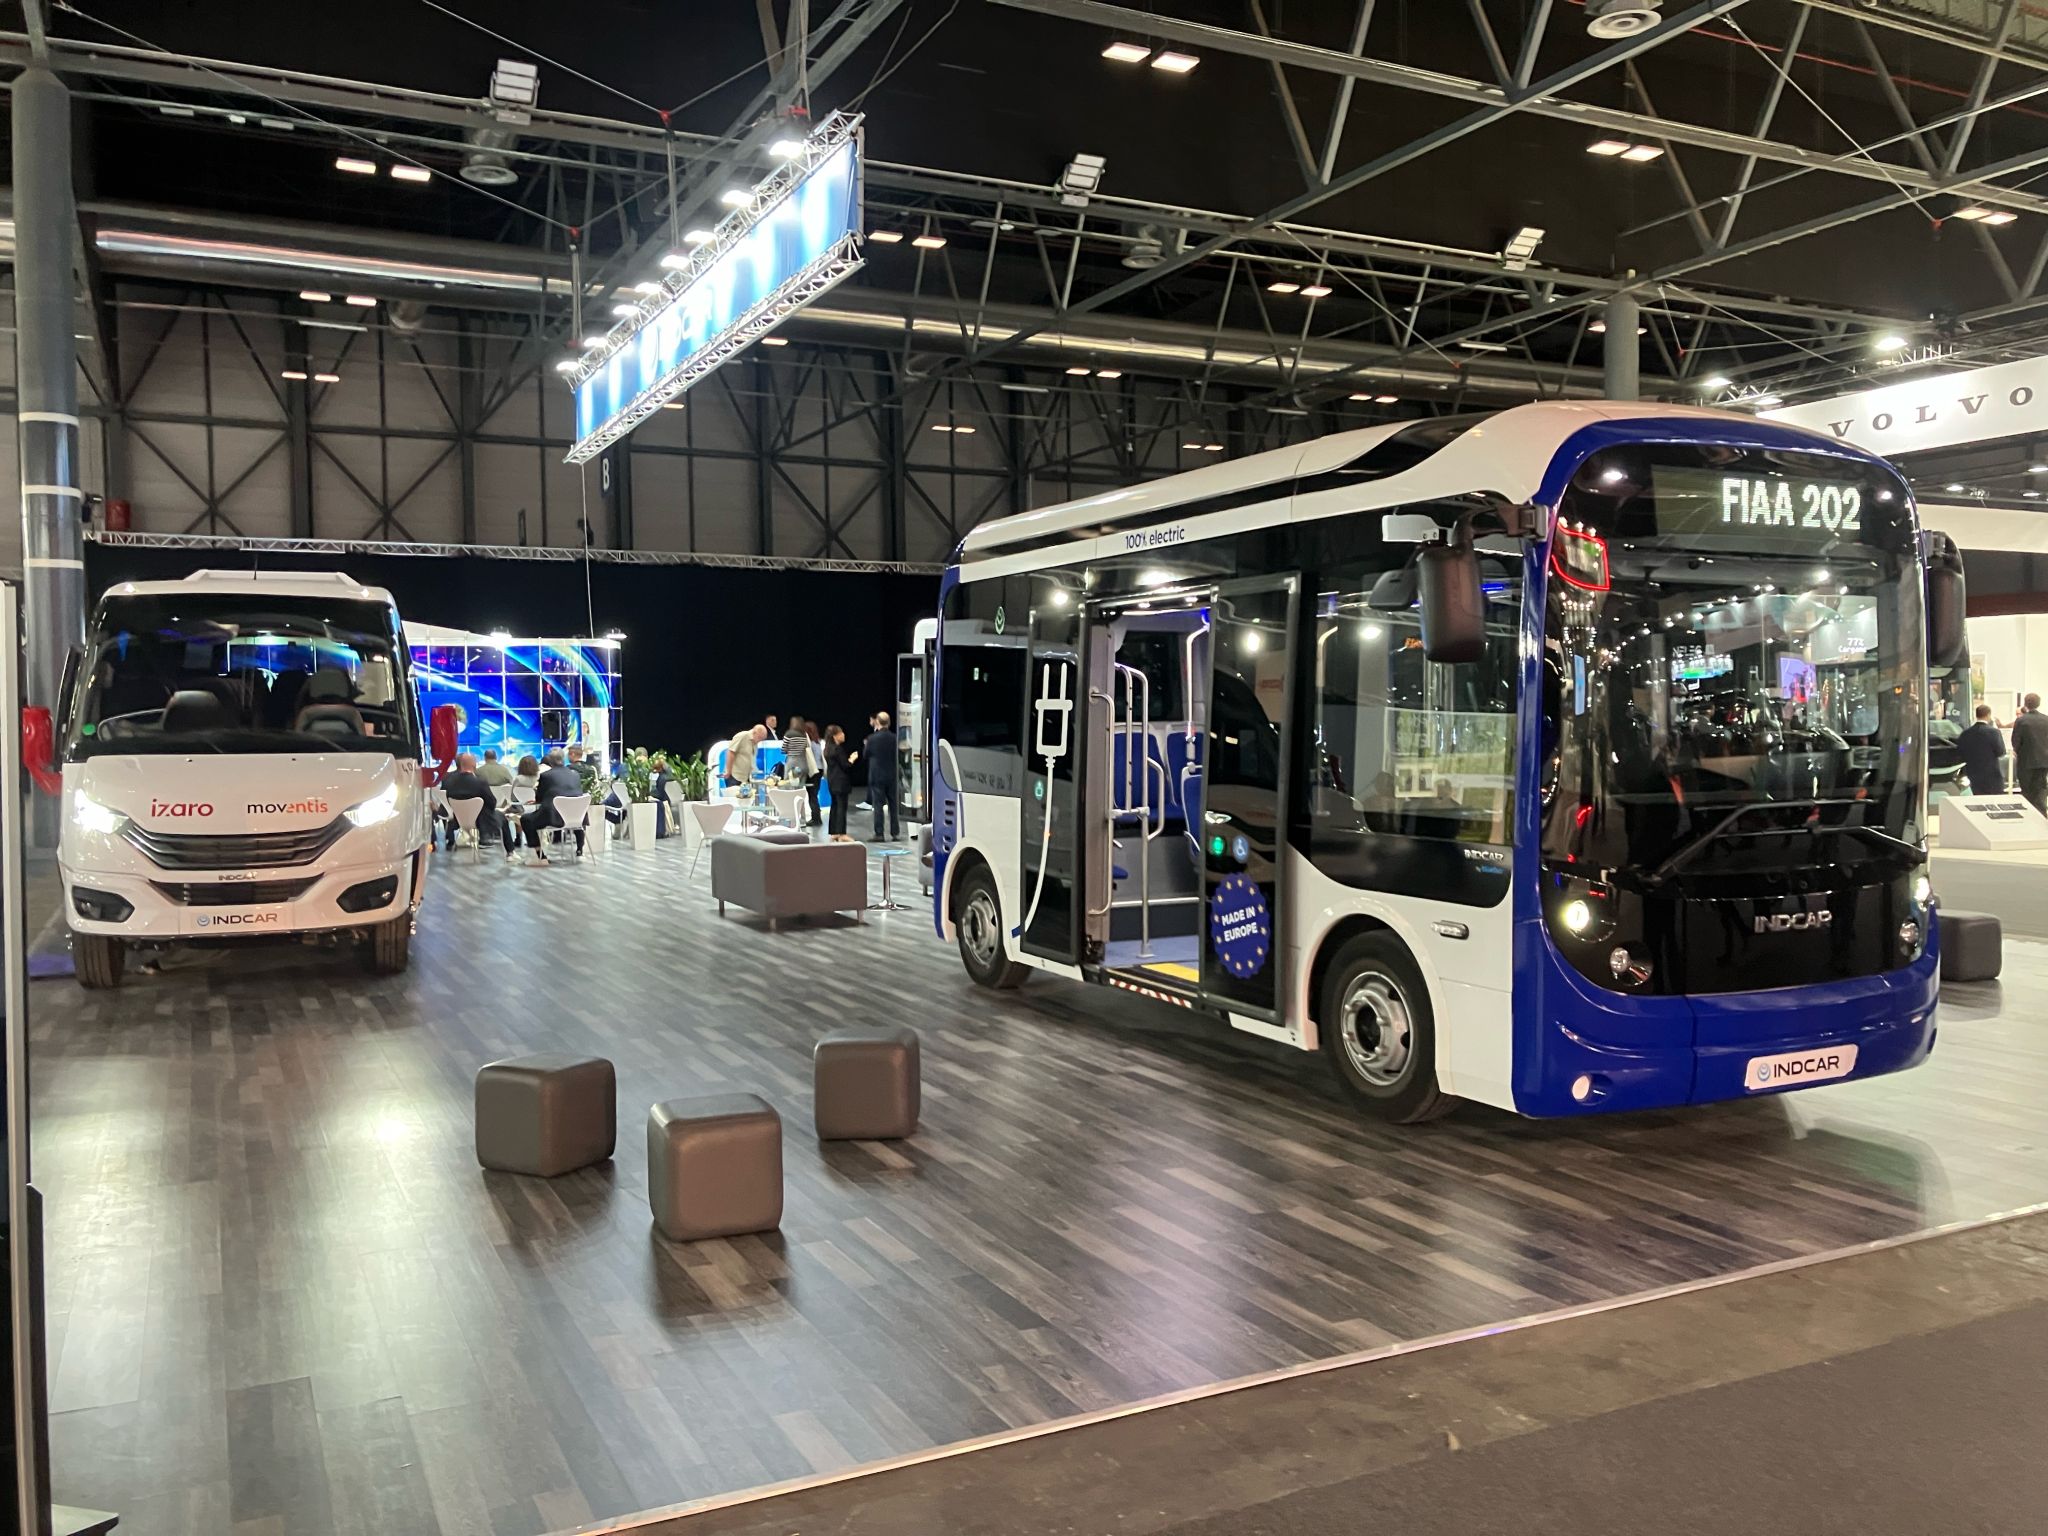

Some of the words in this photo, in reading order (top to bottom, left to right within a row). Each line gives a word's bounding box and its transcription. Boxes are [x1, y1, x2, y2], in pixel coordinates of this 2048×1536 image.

[1828, 386, 2033, 438] VOLVO
[1722, 478, 1795, 526] FIAA
[1802, 484, 1861, 530] 202
[1149, 525, 1185, 545] electric
[151, 798, 214, 817] izaro
[247, 800, 328, 814] moventis
[213, 914, 278, 925] INDCAR
[1221, 909, 1245, 926] MADE
[1245, 906, 1256, 919] IN
[1754, 910, 1833, 933] INDCAR
[1223, 922, 1258, 942] EUROPE
[1773, 1055, 1840, 1078] INDCAR
